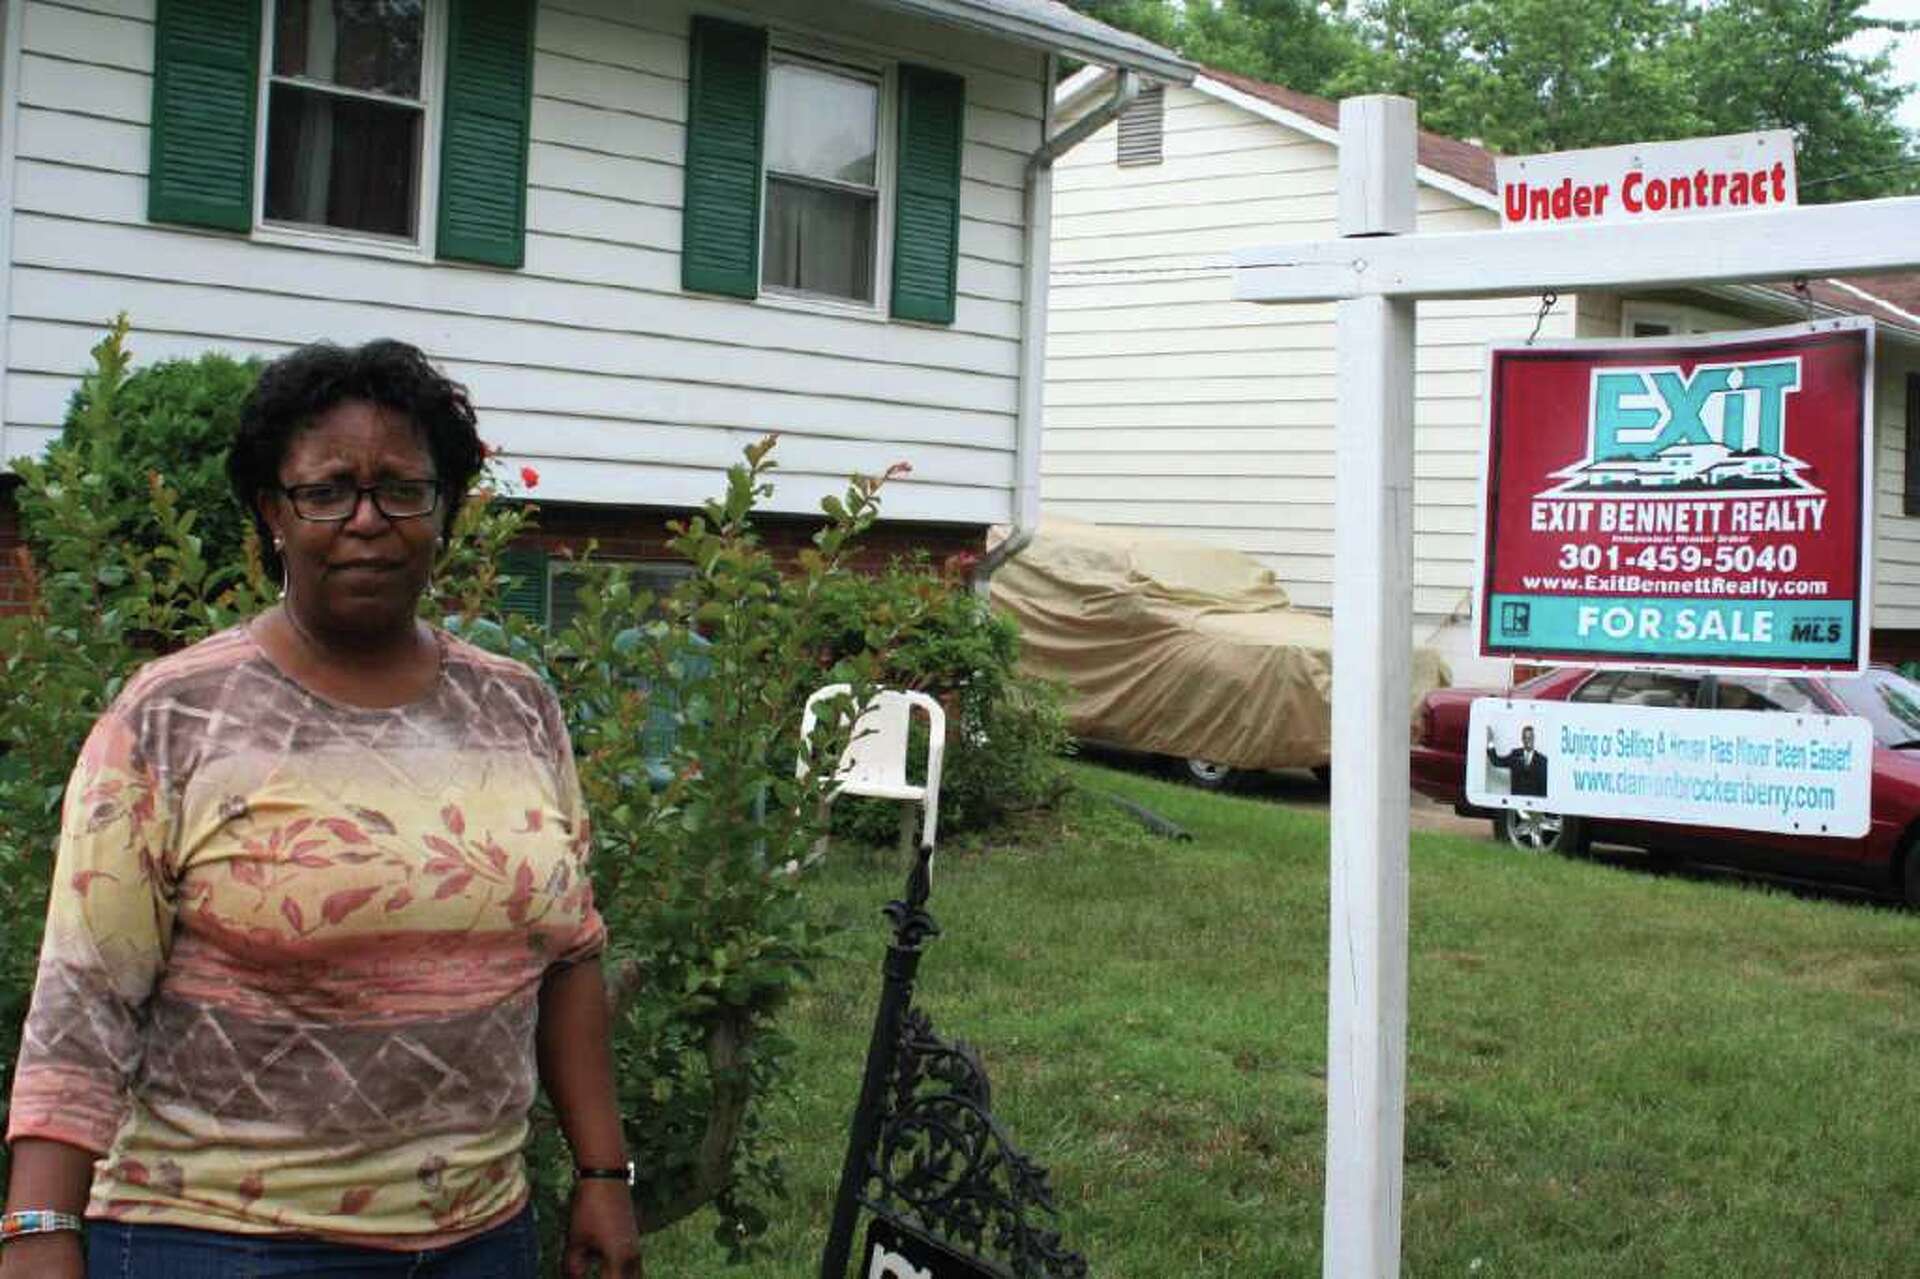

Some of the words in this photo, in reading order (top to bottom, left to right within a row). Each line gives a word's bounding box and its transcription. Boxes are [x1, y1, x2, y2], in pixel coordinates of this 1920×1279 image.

[1505, 178, 1609, 222] Under
[1621, 161, 1786, 213] Contract
[1531, 501, 1594, 532] EXIT
[1600, 501, 1724, 533] BENNETT
[1732, 498, 1827, 532] REALTY
[1559, 544, 1798, 573] 301-459-5040
[1522, 574, 1829, 598] www.ExitBennettRealty.com
[1577, 606, 1662, 639] FOR
[1675, 608, 1774, 642] SALE
[1790, 624, 1842, 644] MLS
[1561, 725, 1599, 762] Buying
[1601, 734, 1613, 757] or
[1616, 728, 1655, 763] Selling
[1775, 737, 1806, 769] Been
